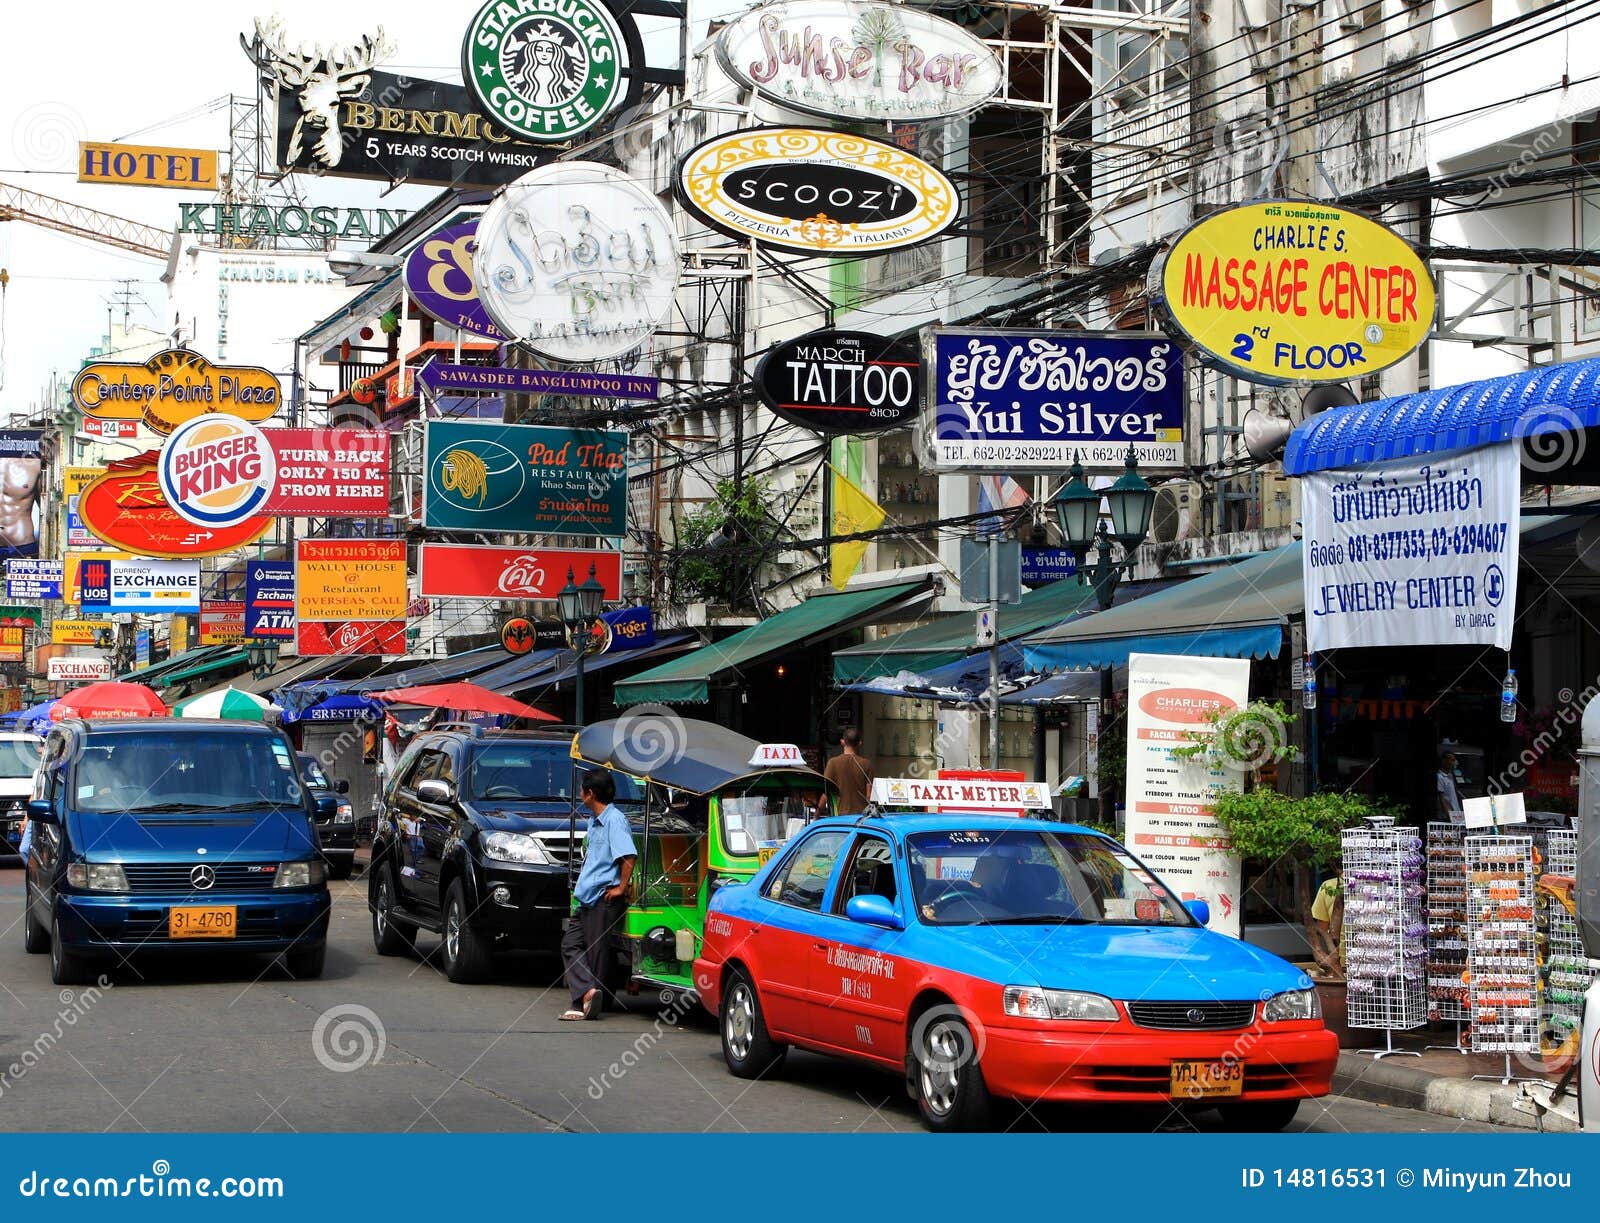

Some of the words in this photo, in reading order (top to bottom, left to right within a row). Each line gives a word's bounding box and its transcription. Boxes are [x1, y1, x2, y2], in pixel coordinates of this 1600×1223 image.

[477, 0, 612, 64] STARBUCKS
[894, 37, 977, 93] Bar
[489, 86, 595, 132] COFFEE
[365, 137, 380, 159] 5
[387, 143, 426, 158] YEARS
[431, 146, 484, 163] SCOTCH
[488, 151, 539, 168] WHISKY
[83, 150, 211, 183] HOTEL
[178, 203, 408, 239] KHAOSAN
[724, 210, 790, 237] PIZZERIA
[853, 226, 913, 243] ITALIANA
[1183, 252, 1309, 318] MASSAGE
[1318, 260, 1418, 324] CENTER
[458, 314, 481, 331] The
[796, 346, 866, 363] MARCH
[1274, 341, 1367, 370] FLOOR
[145, 352, 206, 377] HOTEL
[440, 370, 515, 385] SAWASDEE
[522, 374, 622, 392] BANGLUMPOO
[628, 383, 652, 393] INN
[786, 361, 913, 407] TATTOO
[78, 374, 156, 409] Center
[159, 374, 214, 403] Point
[219, 376, 276, 404] Plaza
[956, 401, 1024, 433] Yui
[1039, 402, 1162, 435] Silver
[103, 421, 117, 434] 24
[175, 435, 258, 475] BURGER
[279, 450, 329, 463] TURN
[334, 451, 385, 463] BACK
[527, 441, 572, 467] Pad
[576, 443, 625, 469] Thai
[944, 446, 969, 460] TEL.
[973, 446, 1062, 461] 662-02-2829224
[1092, 447, 1177, 462] 662-022810921
[178, 453, 262, 502] KING
[279, 467, 327, 480] ONLY
[333, 467, 361, 480] 150
[365, 468, 385, 480] M.
[532, 468, 618, 481] RESTAURANT
[279, 484, 330, 497] FROM
[336, 485, 385, 498] HERE
[541, 480, 563, 489] Khao
[566, 482, 585, 490] Sarn
[1331, 465, 1483, 524] มีพื้นที่ว่างให้เช่า
[1310, 537, 1344, 568] ติดต่อ
[307, 563, 349, 572] WALLY
[355, 563, 398, 572] HOUSE
[1041, 571, 1069, 580] STREET
[113, 575, 197, 586] EXCHANGE
[344, 573, 360, 584] @
[84, 589, 108, 598] UOB
[301, 596, 366, 605] OVERSEAS
[371, 597, 403, 605] CALL
[1313, 580, 1398, 617] JEWELRY
[1406, 575, 1476, 609] CENTER
[309, 608, 353, 616] Internet
[358, 607, 396, 616] Printer
[255, 616, 295, 629] ATM
[614, 620, 648, 639] Tiger
[1455, 615, 1466, 628] BY
[51, 663, 110, 674] EXCHANGE
[1156, 697, 1221, 709] CHARLIE'S
[1149, 730, 1176, 740] FACIAL
[762, 747, 799, 759] TAXI
[910, 784, 1021, 802] TAXI-METER
[1168, 804, 1199, 814] TATTOO
[1154, 836, 1173, 844] HAIR
[1176, 837, 1190, 845] CUT
[174, 912, 232, 928] 31-4760
